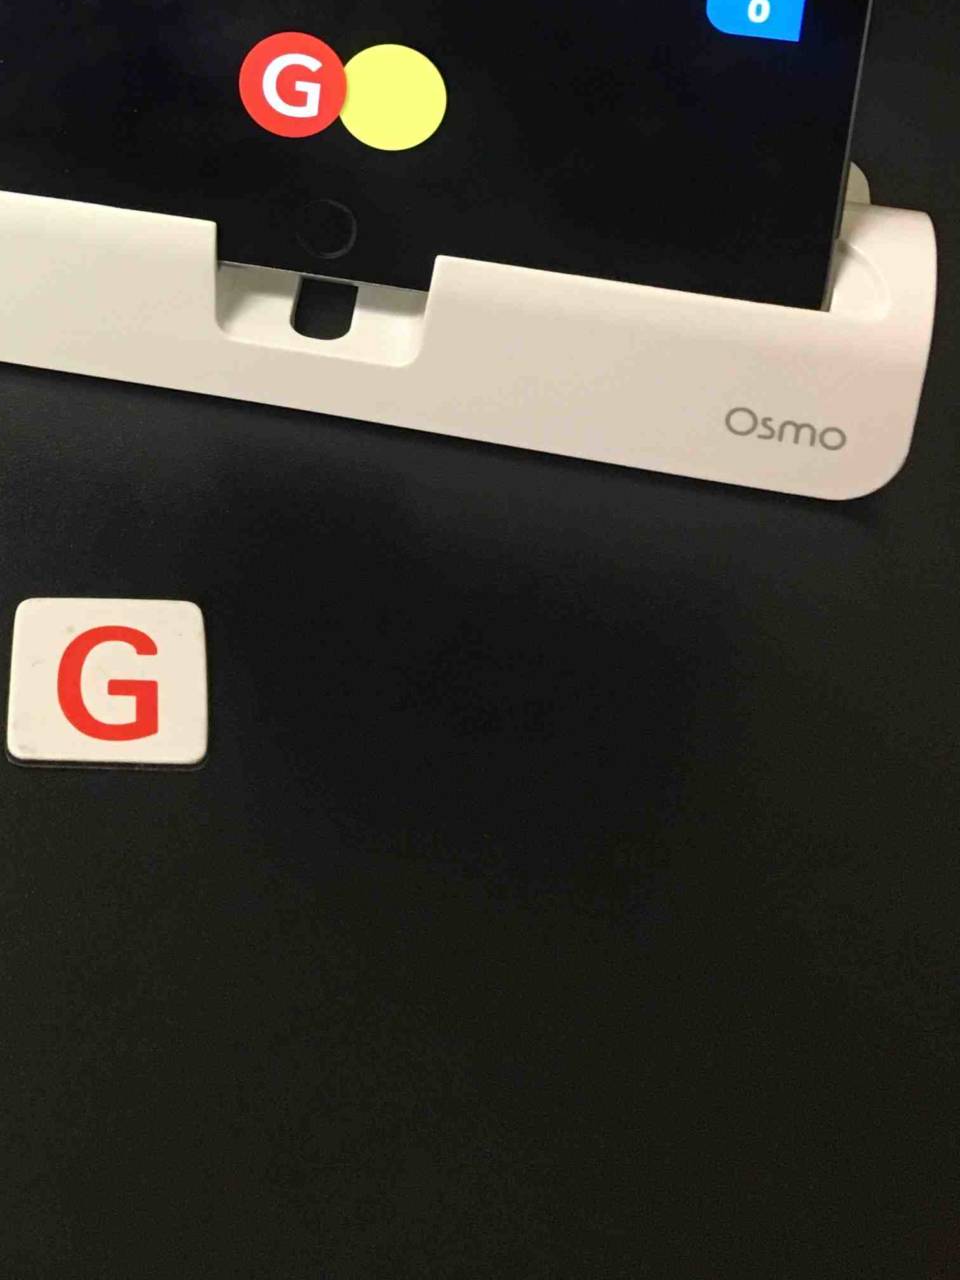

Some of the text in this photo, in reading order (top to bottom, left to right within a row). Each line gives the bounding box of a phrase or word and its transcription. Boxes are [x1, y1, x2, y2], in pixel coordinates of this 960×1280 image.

[262, 52, 323, 119] G
[725, 406, 847, 451] Osmo
[57, 625, 158, 741] G
